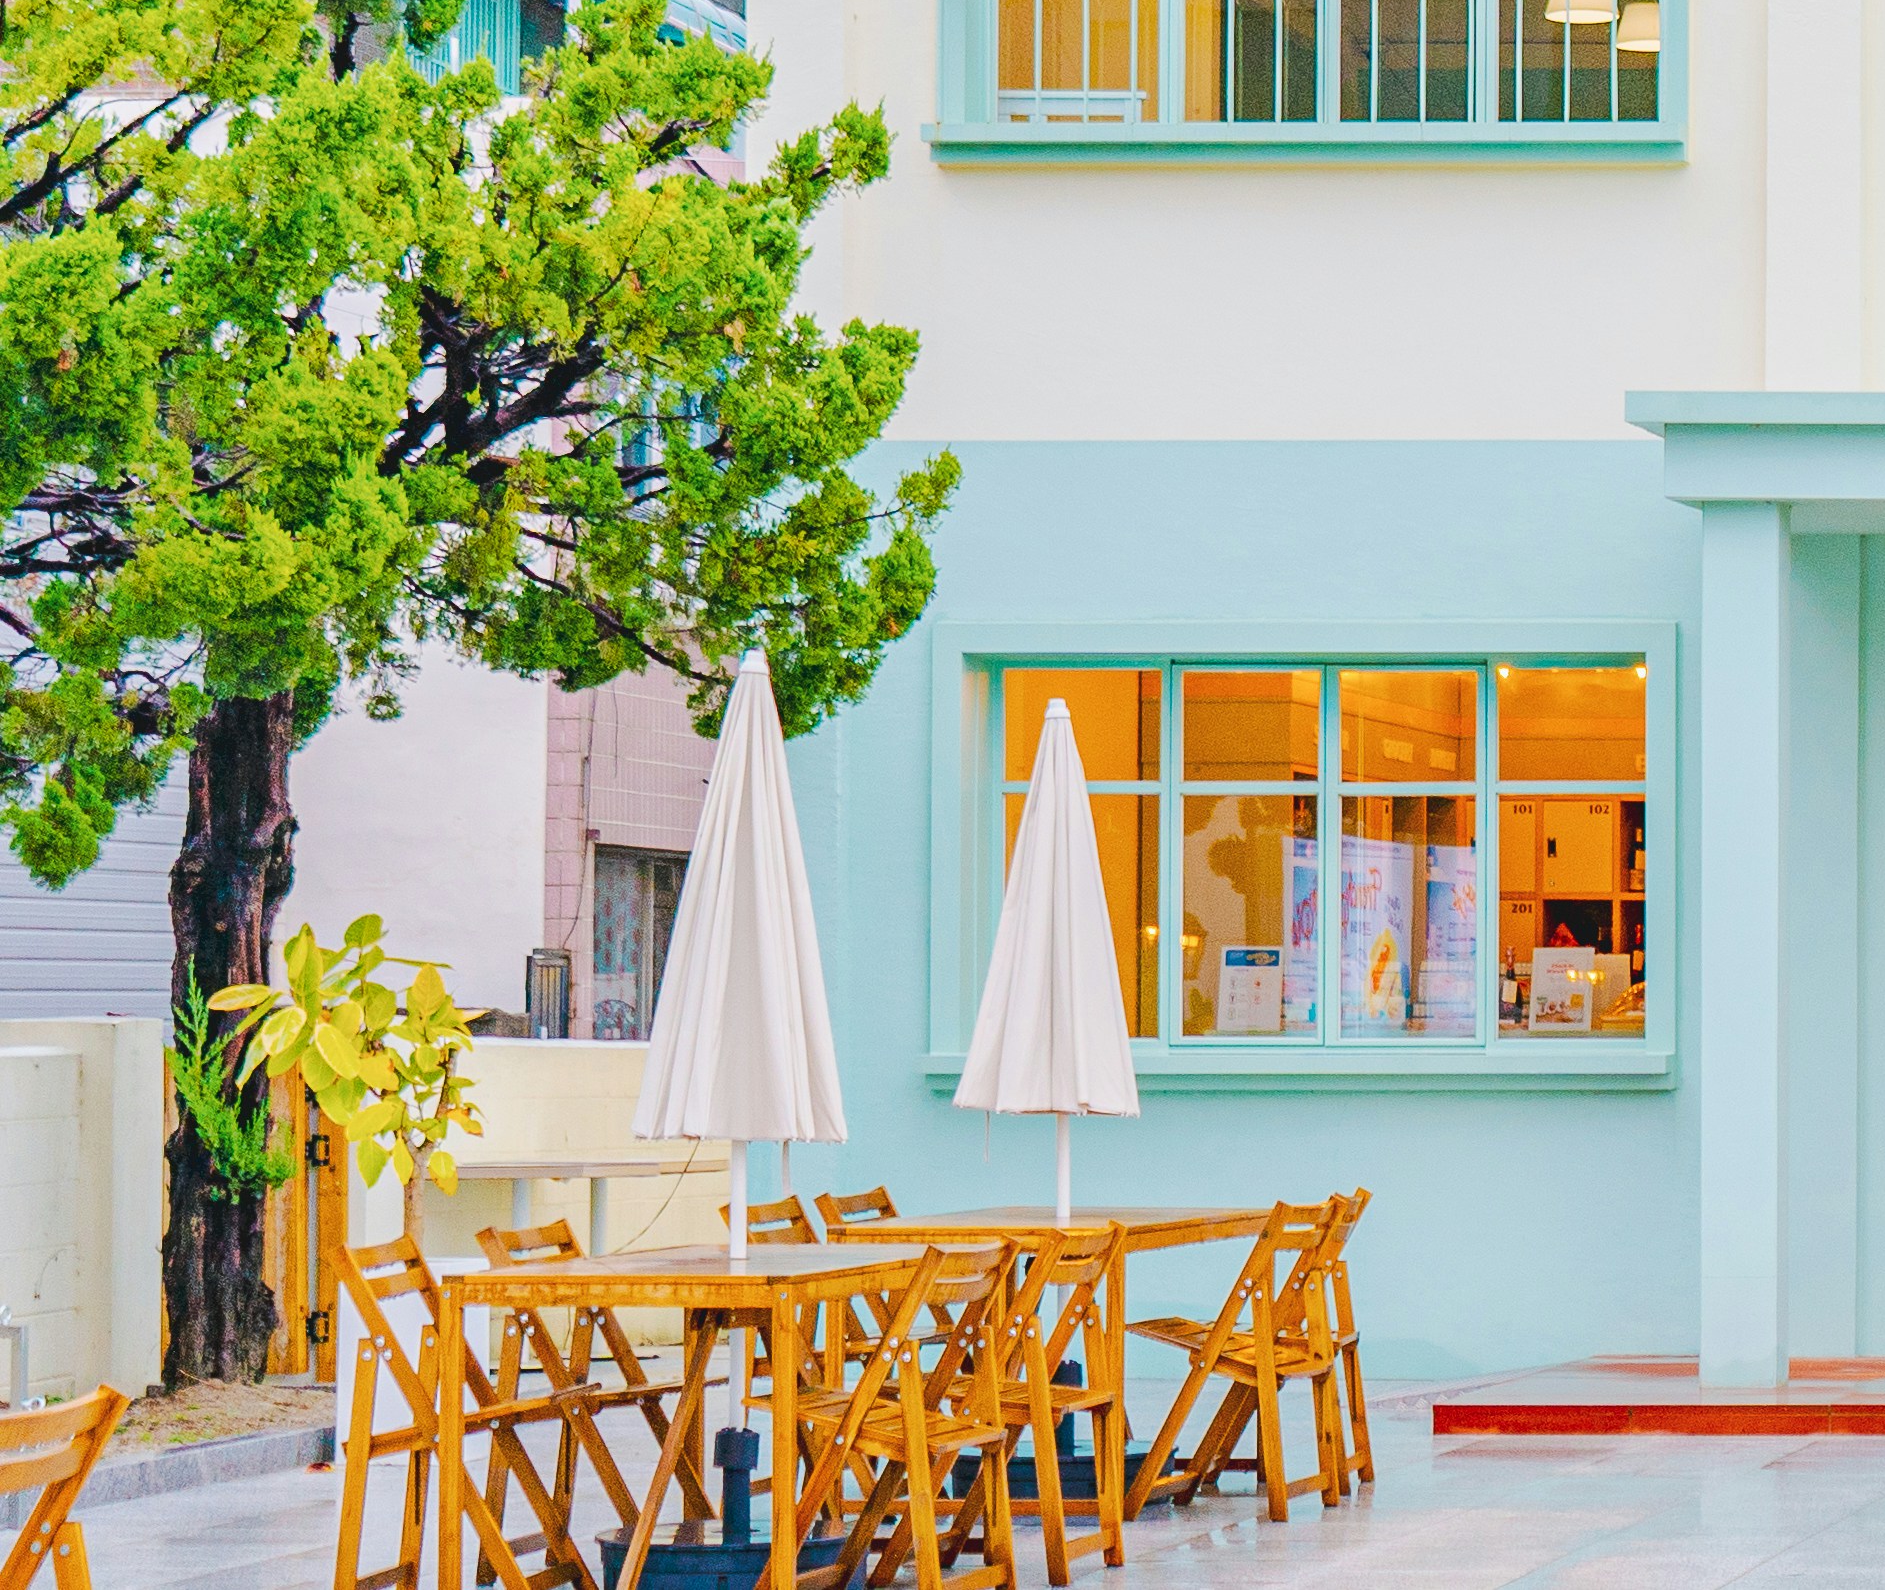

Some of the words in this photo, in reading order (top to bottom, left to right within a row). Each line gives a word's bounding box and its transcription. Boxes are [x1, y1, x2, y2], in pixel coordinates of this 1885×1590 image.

[1513, 804, 1533, 815] 101
[1589, 804, 1610, 815] 102
[1512, 904, 1533, 914] 201
